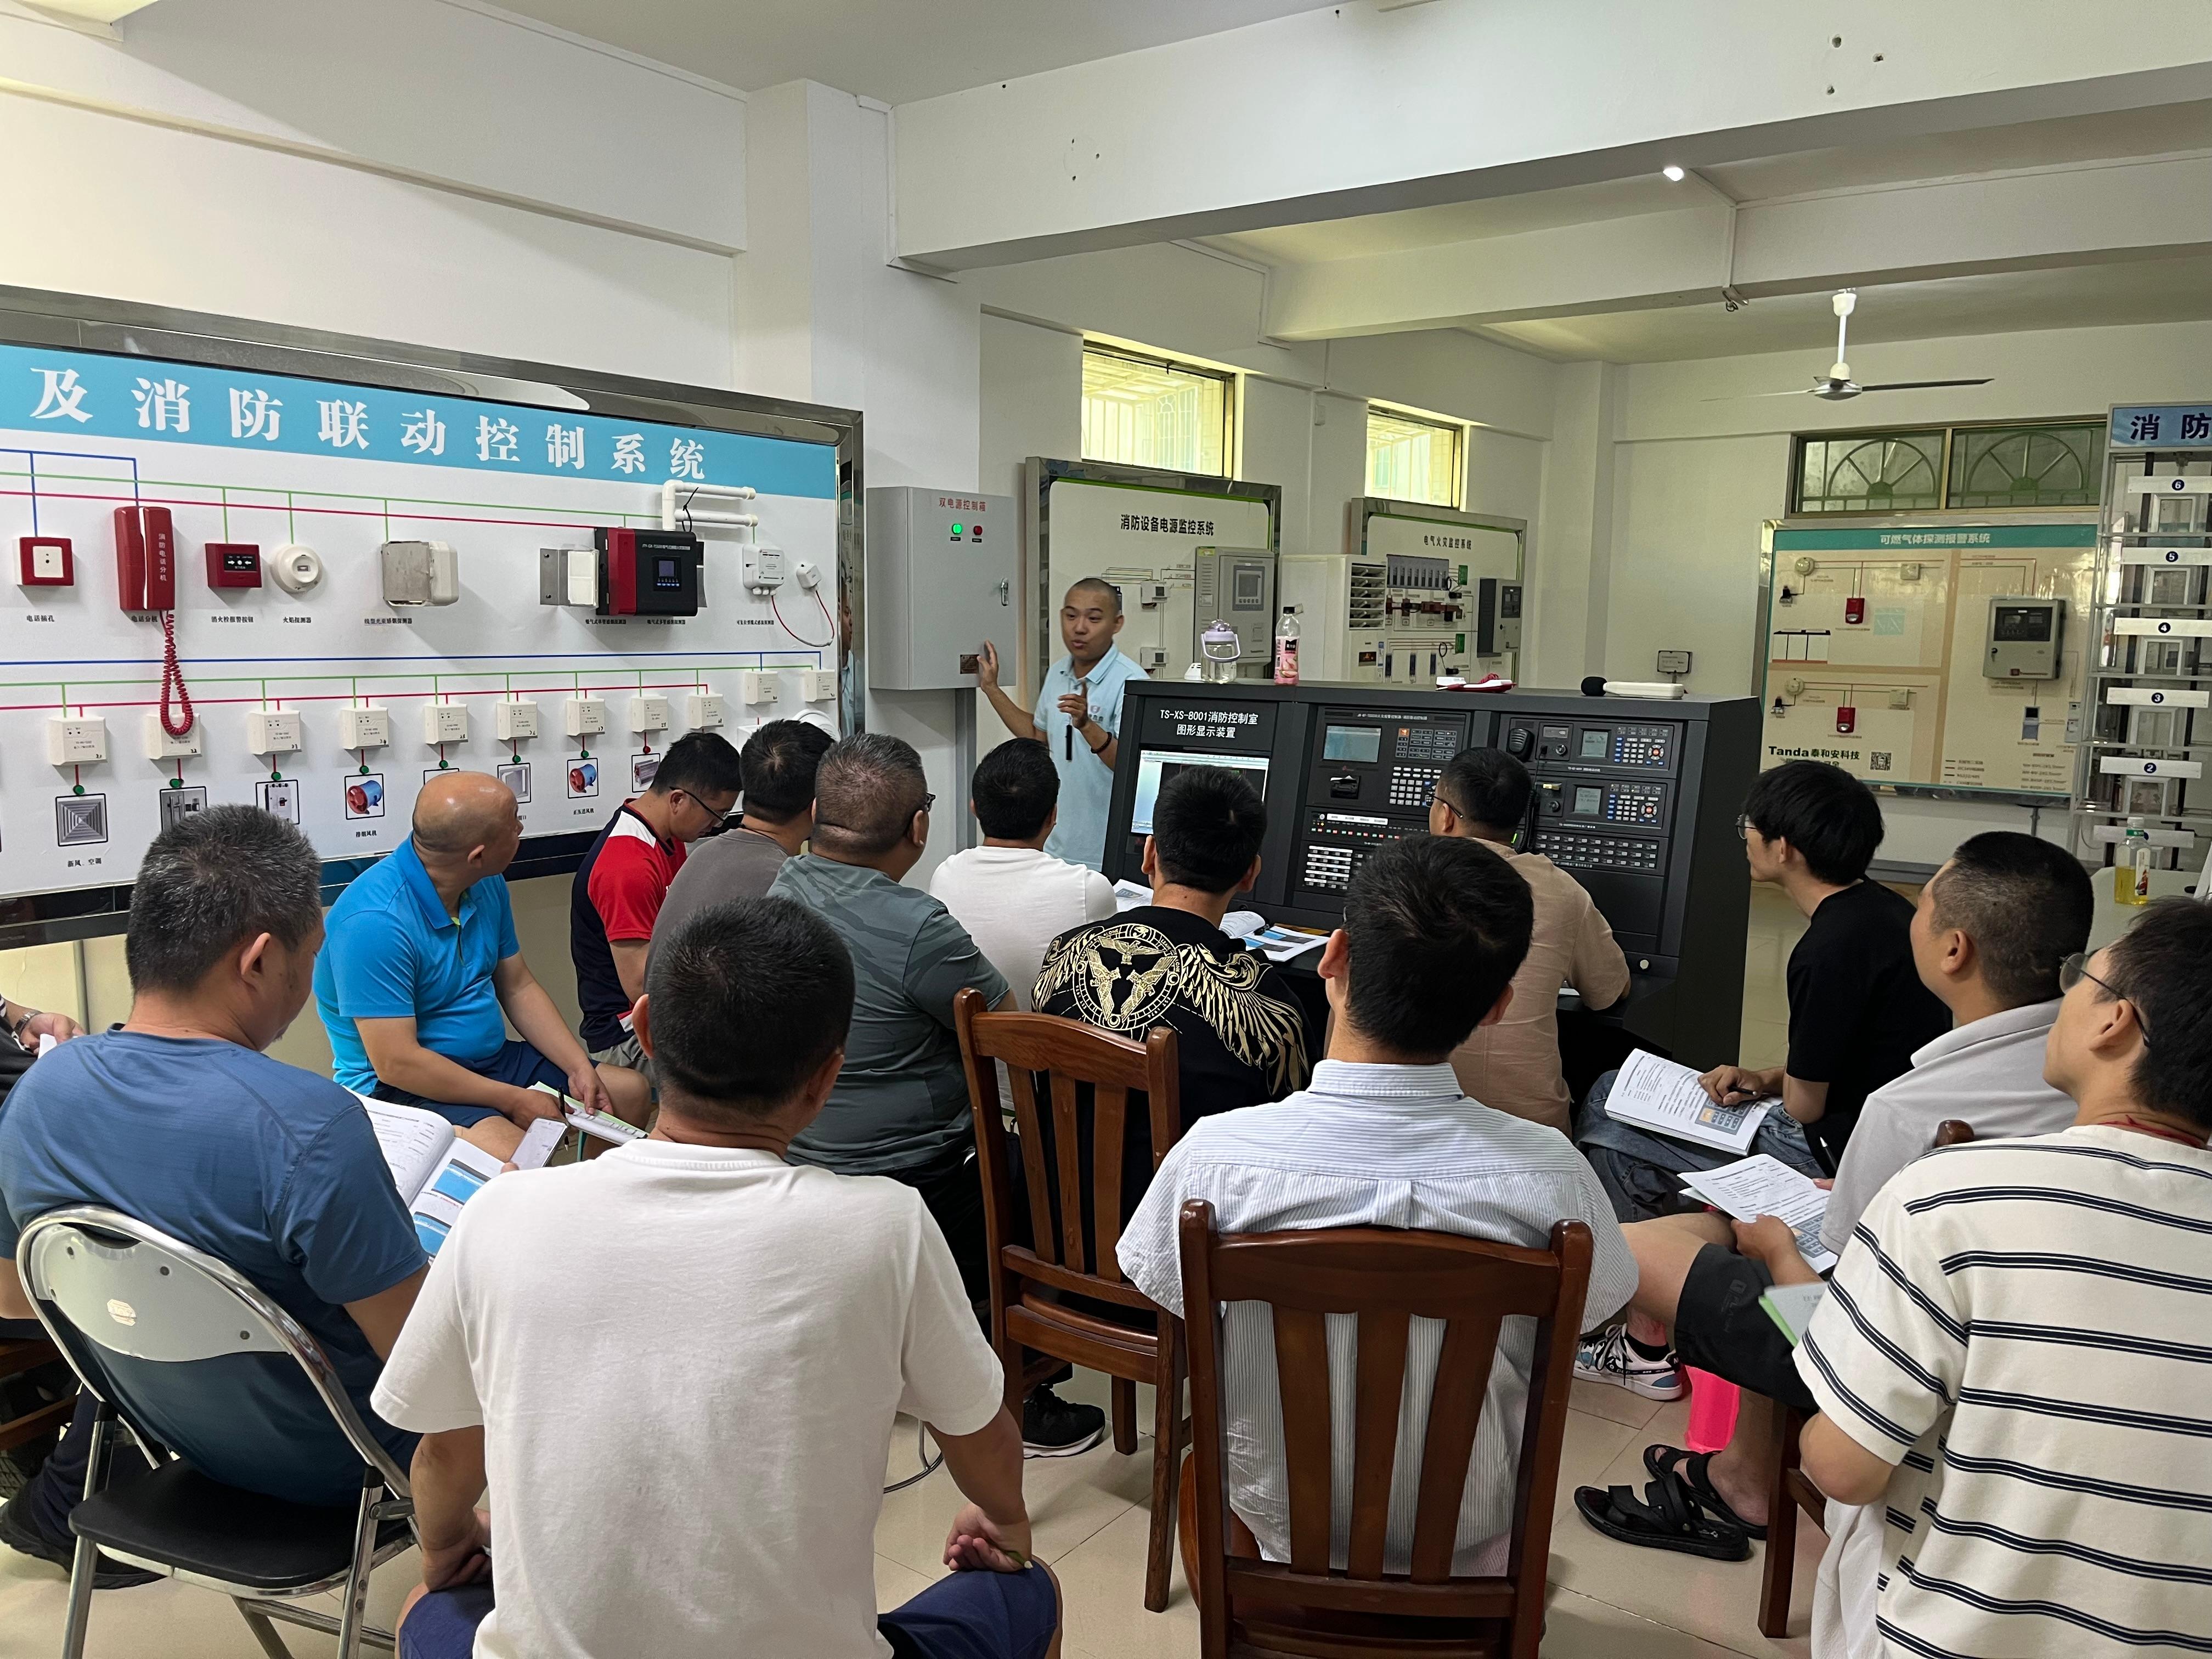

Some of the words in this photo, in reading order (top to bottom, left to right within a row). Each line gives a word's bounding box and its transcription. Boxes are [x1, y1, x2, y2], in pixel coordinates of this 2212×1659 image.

[30, 366, 705, 480] 及消防联动控制系统
[2130, 413, 2212, 440] 消防
[939, 496, 986, 512] 双电源控制箱
[1121, 514, 1214, 536] 消防设备电源监控系统
[1424, 535, 1472, 550] 电气火灾监控系统
[1880, 533, 1991, 545] 可燃气体探测报警系统
[158, 533, 167, 582] 消防电话分机
[1160, 709, 1259, 725] TS-XS-8001消防控制室
[1176, 724, 1236, 738] 图形显示装置
